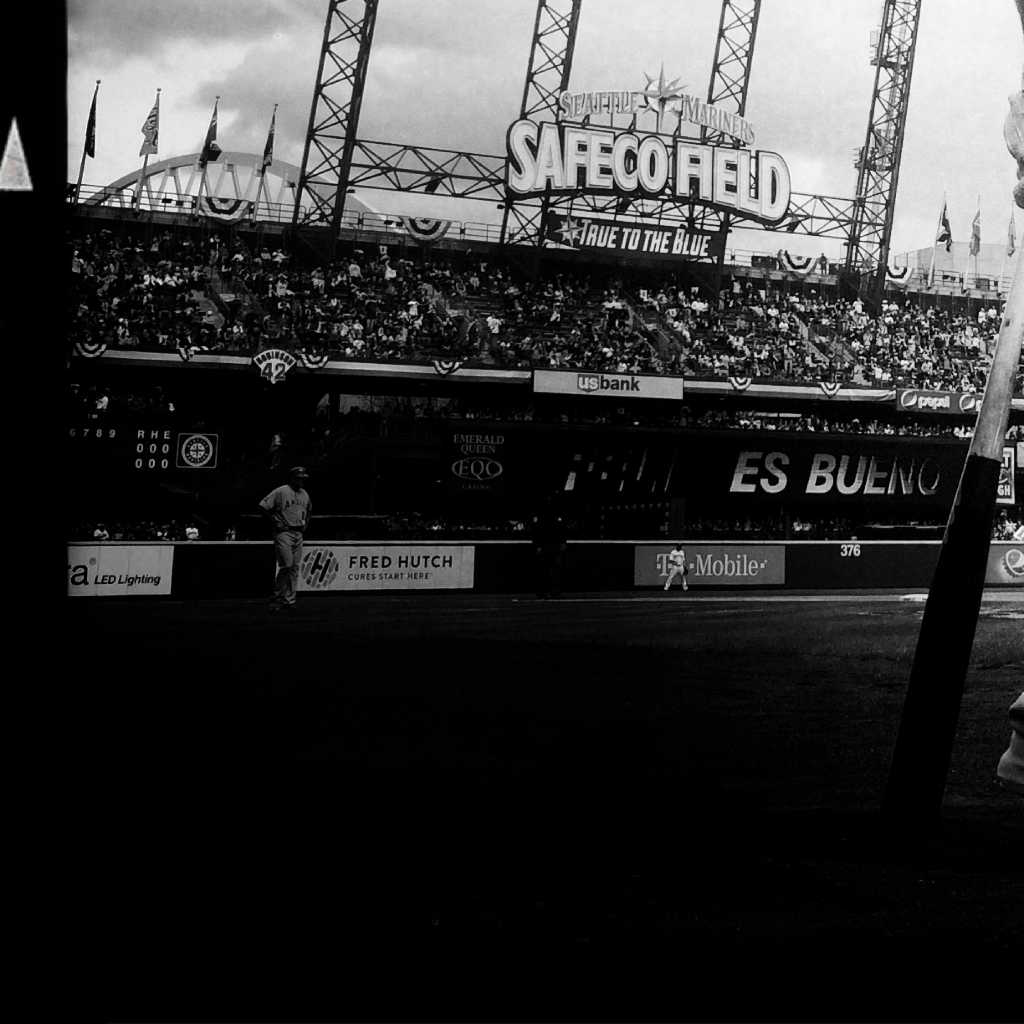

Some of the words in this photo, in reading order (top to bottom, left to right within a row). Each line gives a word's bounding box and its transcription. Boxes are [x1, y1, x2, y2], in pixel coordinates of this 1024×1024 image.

[507, 119, 669, 194] SAFECO
[675, 138, 791, 221] FIELD
[579, 219, 619, 249] TRUE
[621, 228, 642, 250] TO
[642, 229, 672, 254] THE
[672, 228, 712, 257] BLUE
[262, 363, 286, 380] 42
[917, 395, 950, 410] pepsi
[452, 433, 504, 445] EMERALD
[460, 444, 496, 455] QUEEN
[729, 450, 791, 494] ES
[805, 452, 941, 495] BUENO
[840, 544, 861, 557] 376
[350, 555, 392, 569] FRED
[398, 555, 453, 569] HUTCH
[94, 574, 116, 585] LED
[118, 574, 161, 586] Lighting
[348, 573, 376, 581] CURES
[378, 573, 404, 581] START
[407, 572, 429, 580] HERE
